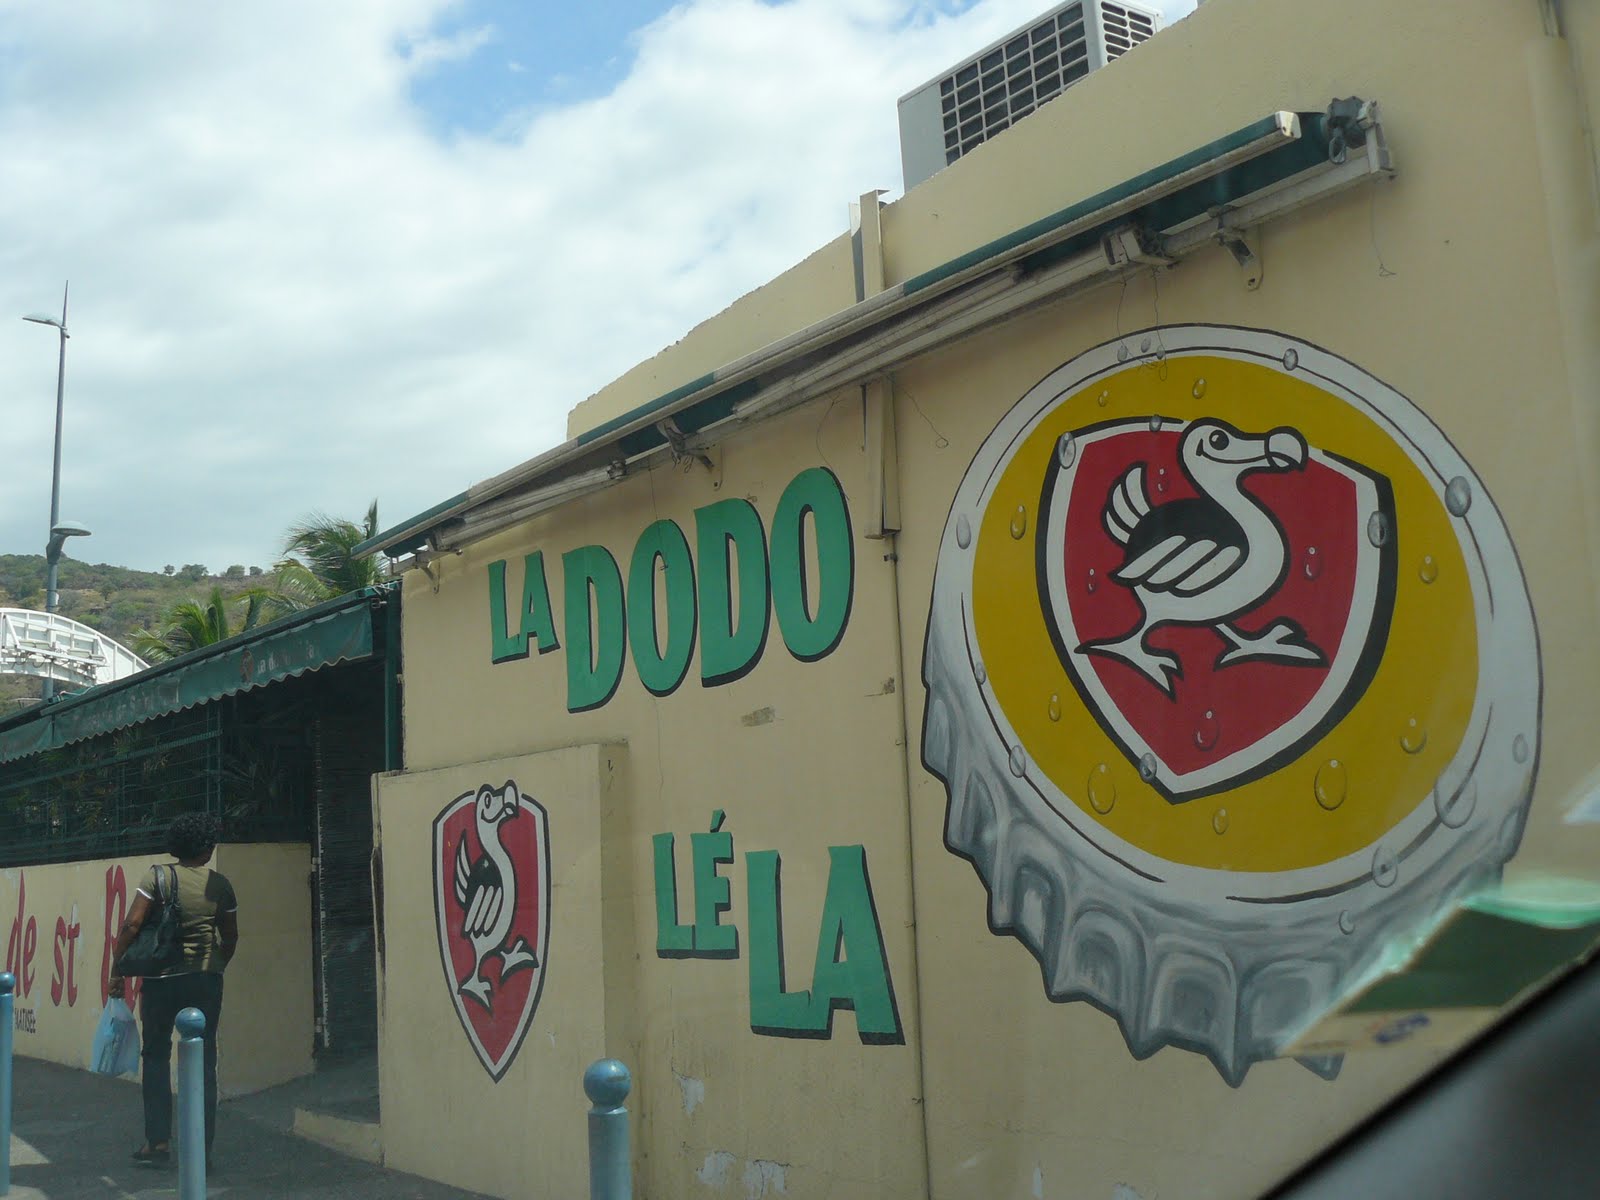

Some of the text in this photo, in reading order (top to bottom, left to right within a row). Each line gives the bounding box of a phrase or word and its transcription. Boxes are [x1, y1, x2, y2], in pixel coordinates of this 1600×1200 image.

[488, 466, 855, 713] LA DODO
[6, 869, 37, 999] de
[51, 915, 80, 1008] st
[652, 809, 906, 1045] LÉ LA
